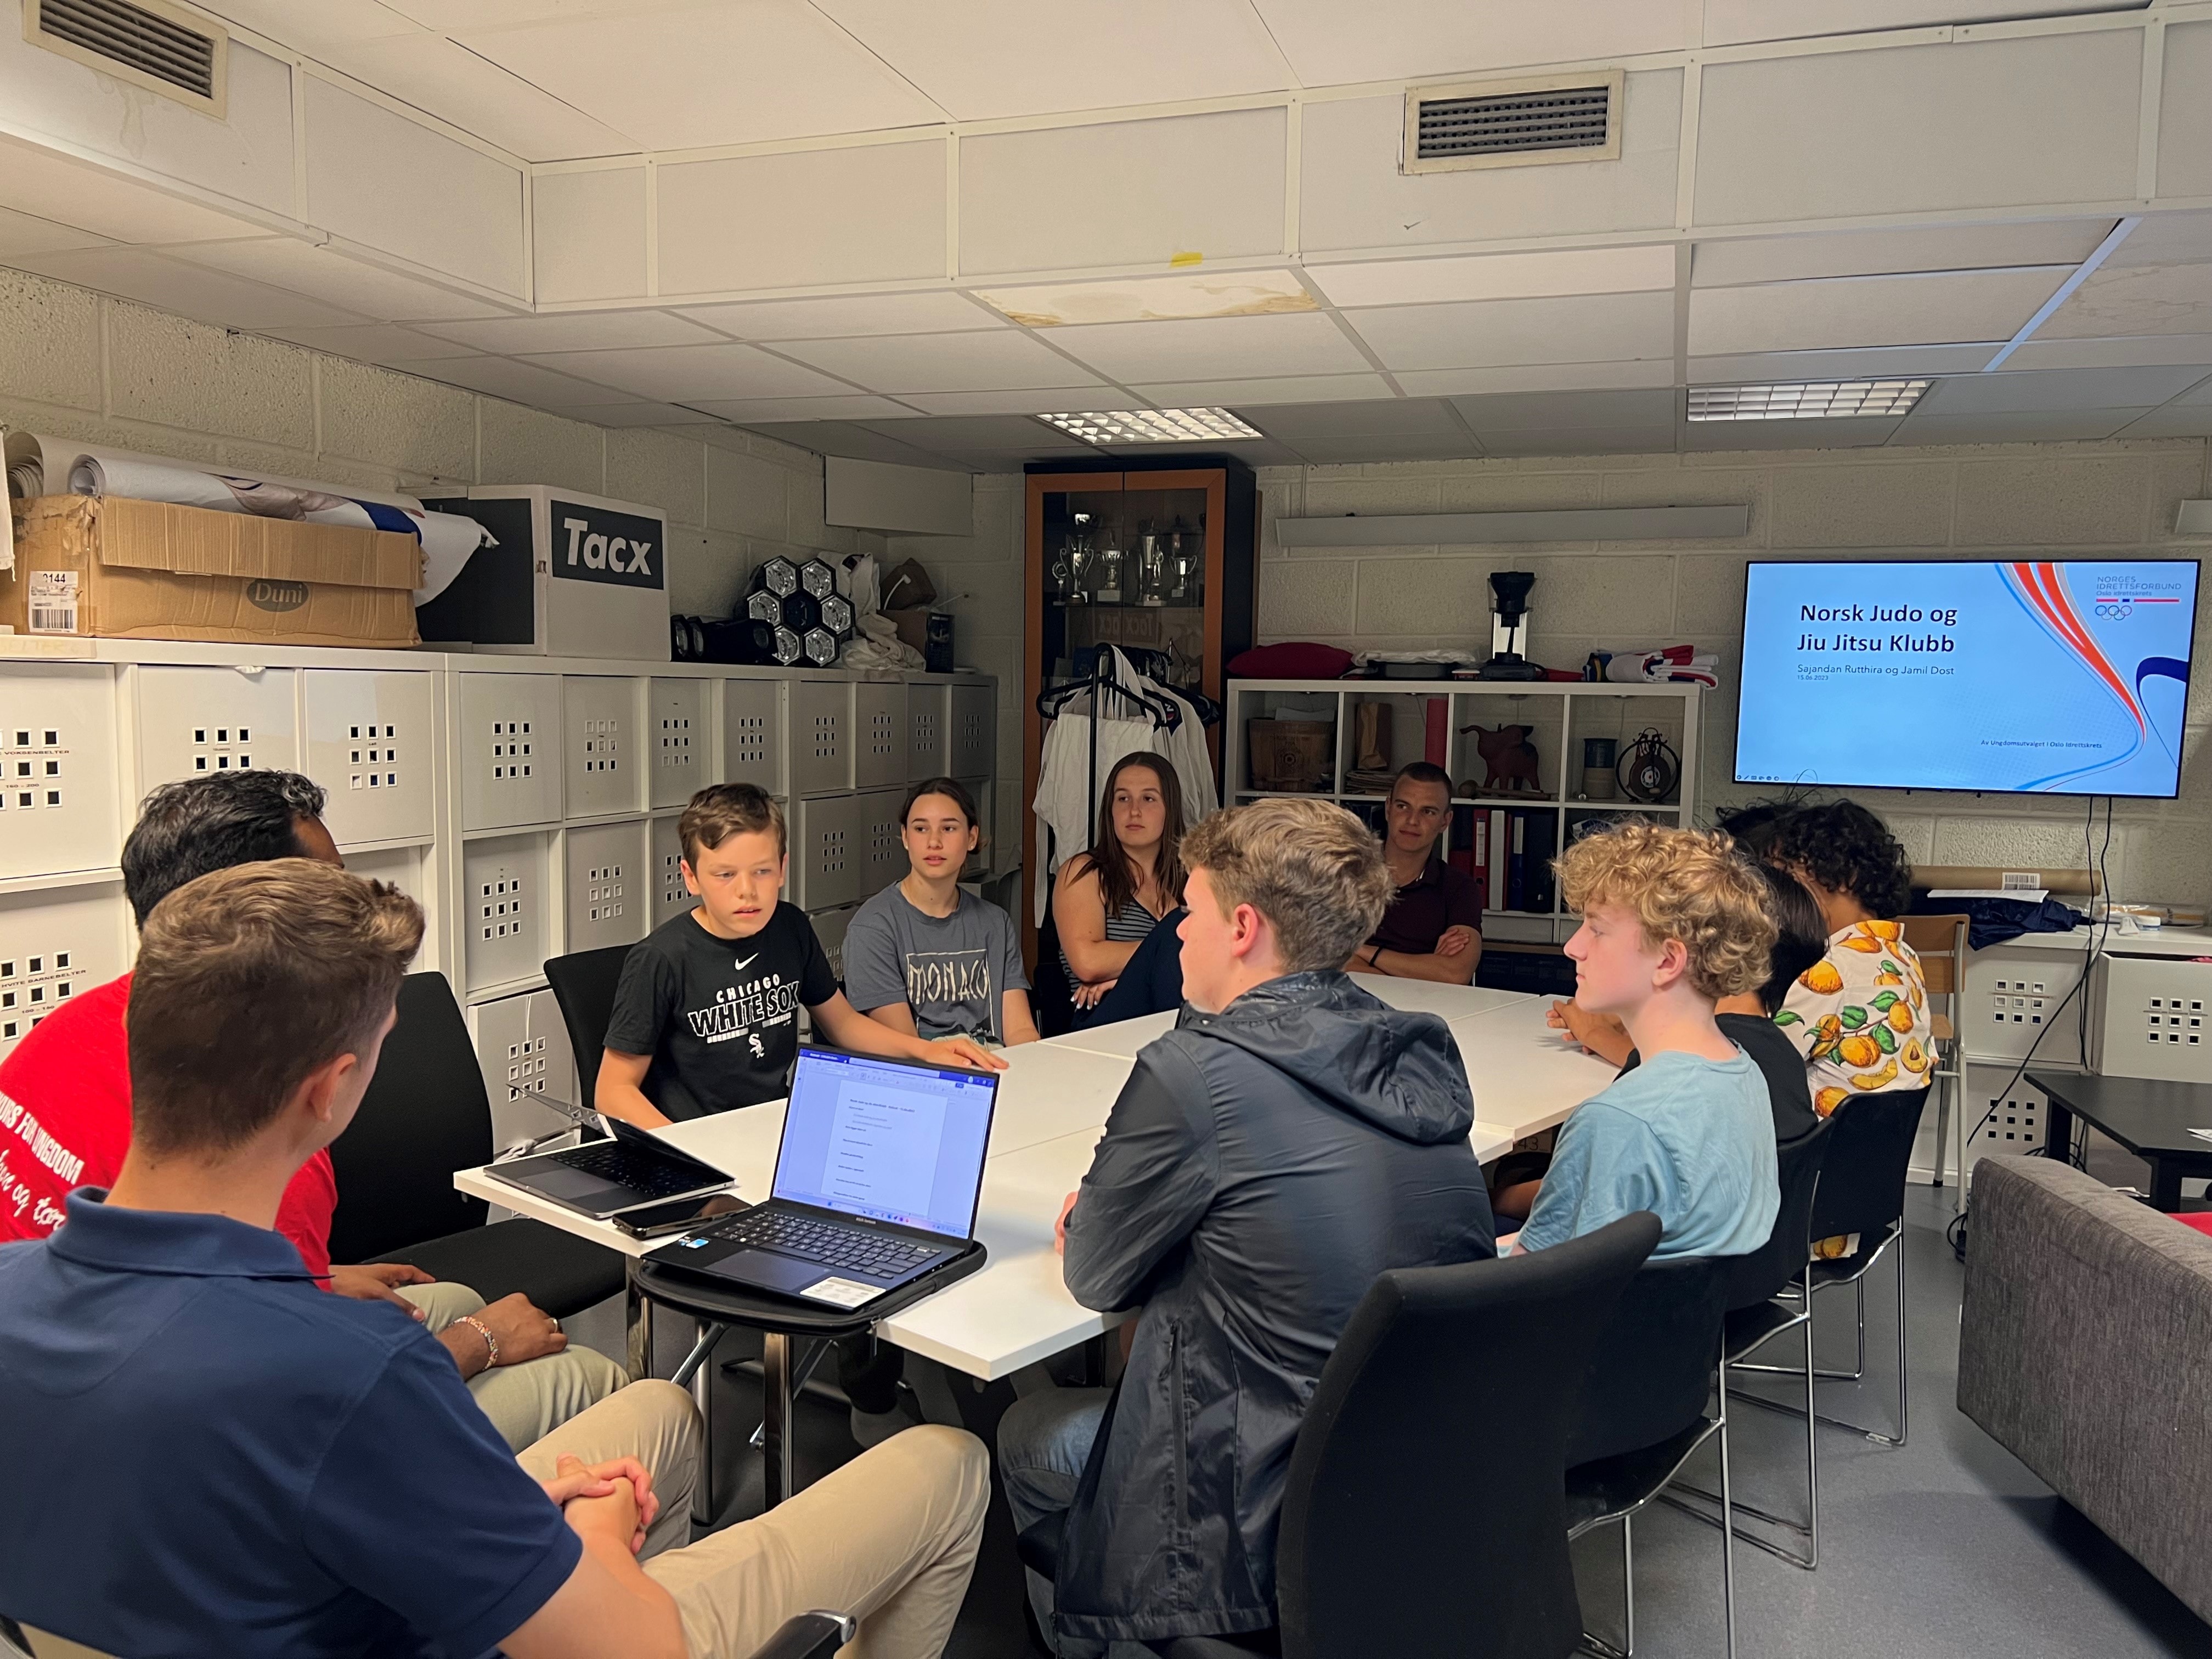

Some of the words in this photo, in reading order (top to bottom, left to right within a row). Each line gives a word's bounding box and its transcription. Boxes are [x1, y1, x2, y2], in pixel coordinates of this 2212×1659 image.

[563, 517, 652, 575] Tacx
[255, 583, 302, 603] Duni
[1800, 604, 1864, 622] Norsk
[1870, 604, 1922, 622] Judo
[1929, 608, 1957, 627] og
[1797, 634, 1826, 651] Jiu
[1832, 634, 1882, 651] Jitsu
[1889, 634, 1955, 652] Klubb
[1797, 664, 1842, 674] Sajandan
[1844, 664, 1882, 674] Rutthira
[1885, 667, 1898, 676] og
[1901, 665, 1928, 675] Jamil
[1931, 666, 1954, 675] Dost
[27, 969, 86, 983] BARNEBELTER
[716, 973, 780, 1003] CHICAGO
[909, 959, 988, 1005] MONACO
[687, 993, 765, 1037] WHITE
[766, 980, 800, 1018] SOX
[14, 1111, 38, 1146] FOR
[31, 1126, 85, 1186] UNGDOM
[12, 1183, 30, 1217] og
